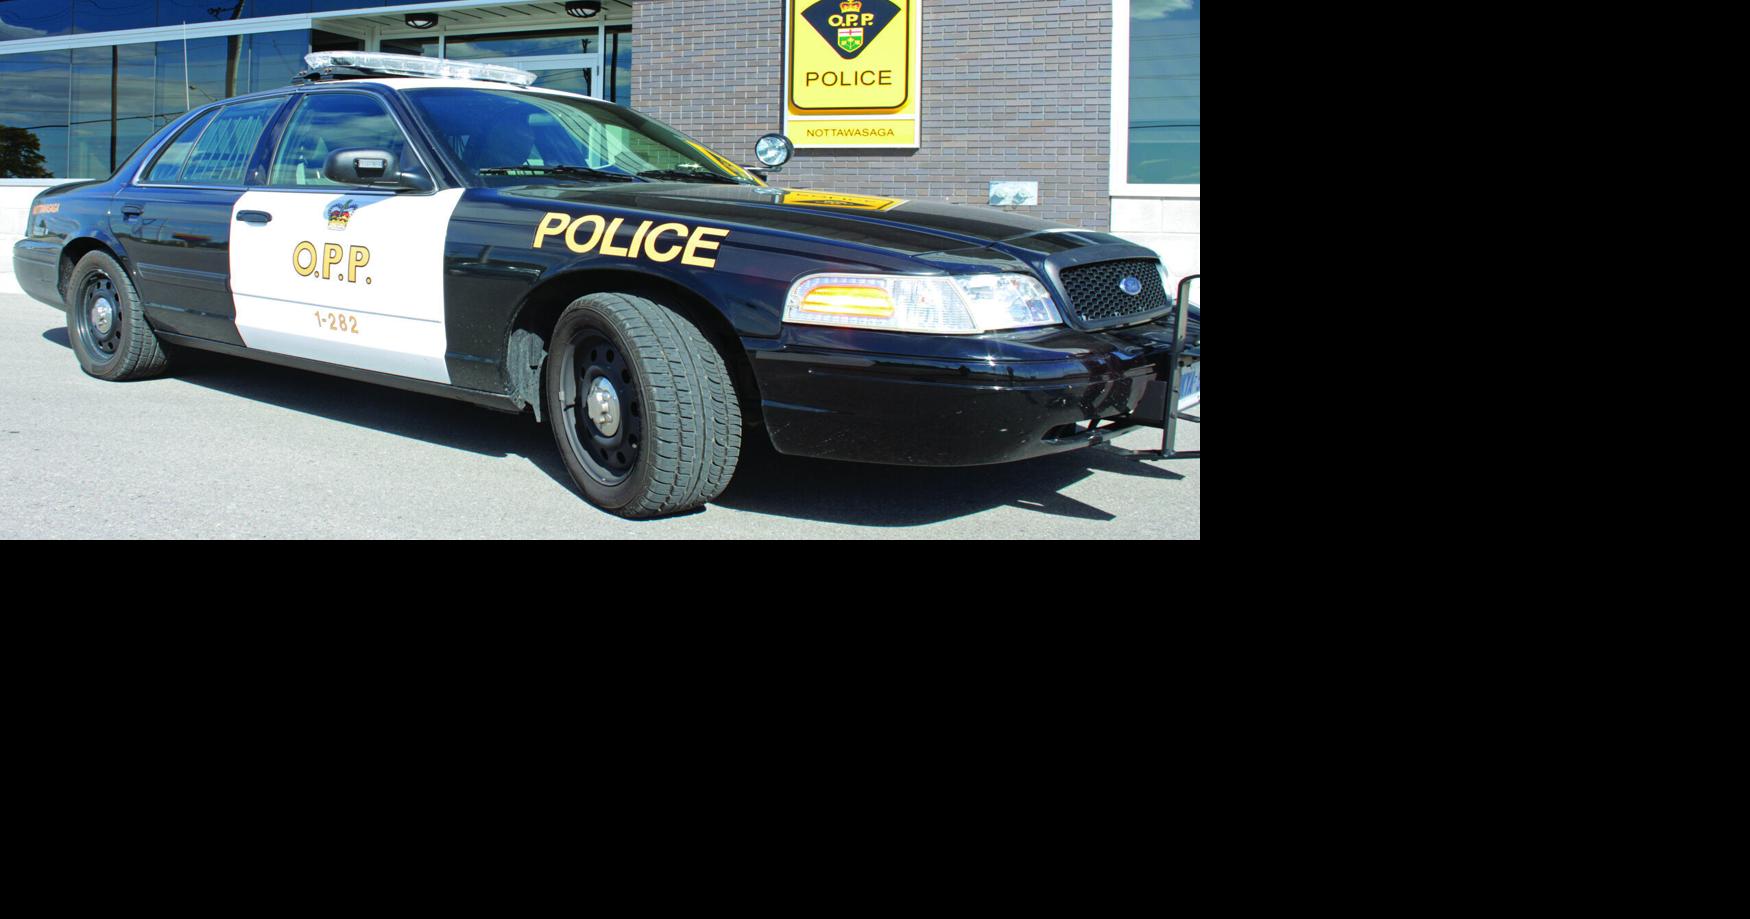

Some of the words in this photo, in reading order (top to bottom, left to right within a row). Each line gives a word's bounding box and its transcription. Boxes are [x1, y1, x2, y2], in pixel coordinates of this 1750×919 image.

[828, 13, 874, 27] O.P.P.
[806, 70, 892, 86] POLICE
[806, 128, 895, 138] NOTTAWASAGA
[532, 212, 730, 268] POLICE
[293, 240, 372, 285] O.P.P.
[314, 311, 360, 334] 1-282
